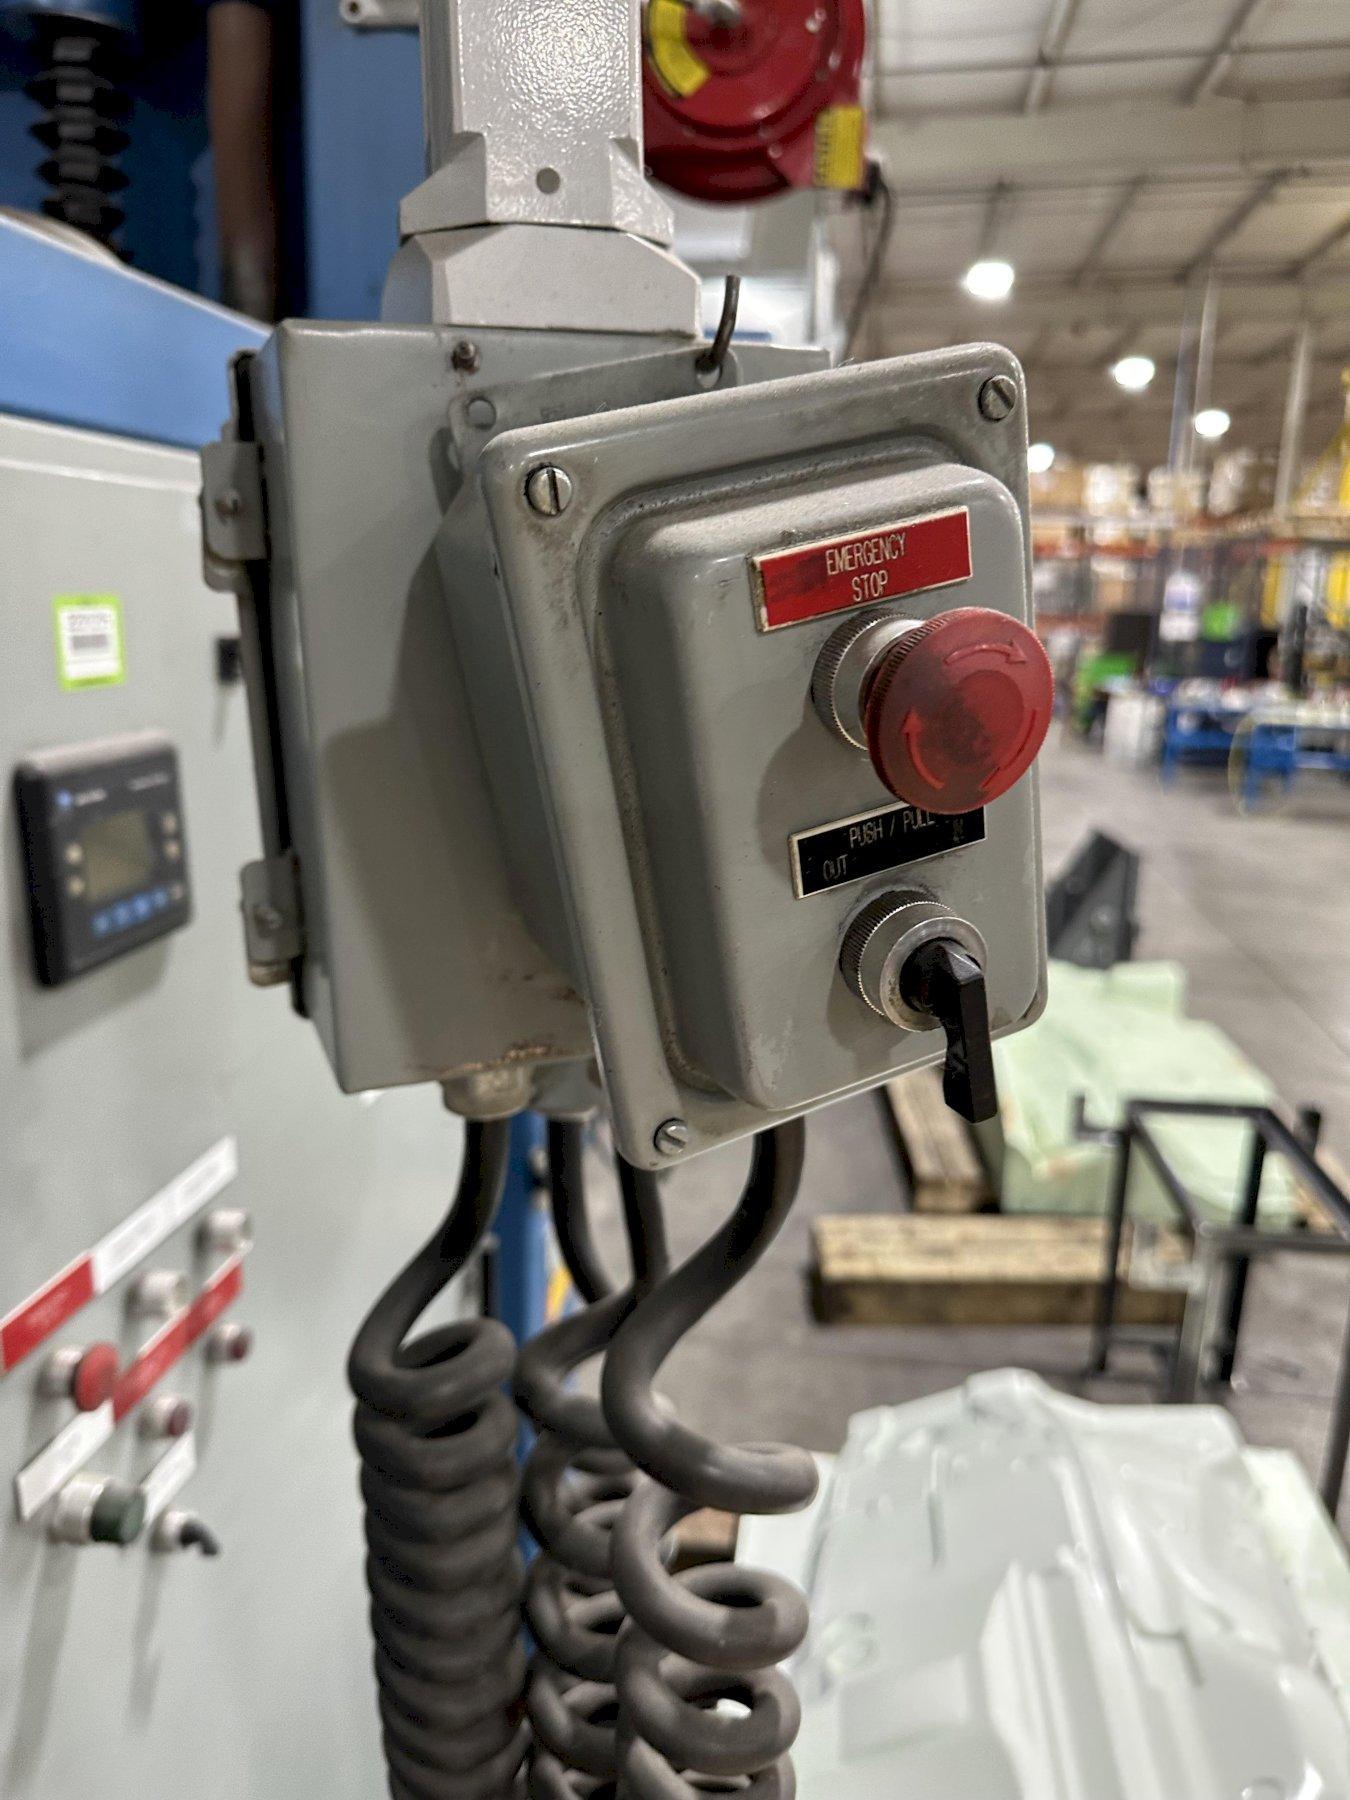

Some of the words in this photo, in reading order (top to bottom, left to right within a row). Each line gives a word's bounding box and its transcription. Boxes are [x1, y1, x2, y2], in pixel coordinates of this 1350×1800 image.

[825, 531, 908, 576] EMERGENCY
[851, 569, 888, 602] STOP
[849, 818, 884, 849] PUSH
[903, 808, 936, 833] PULL
[822, 854, 848, 881] OUT
